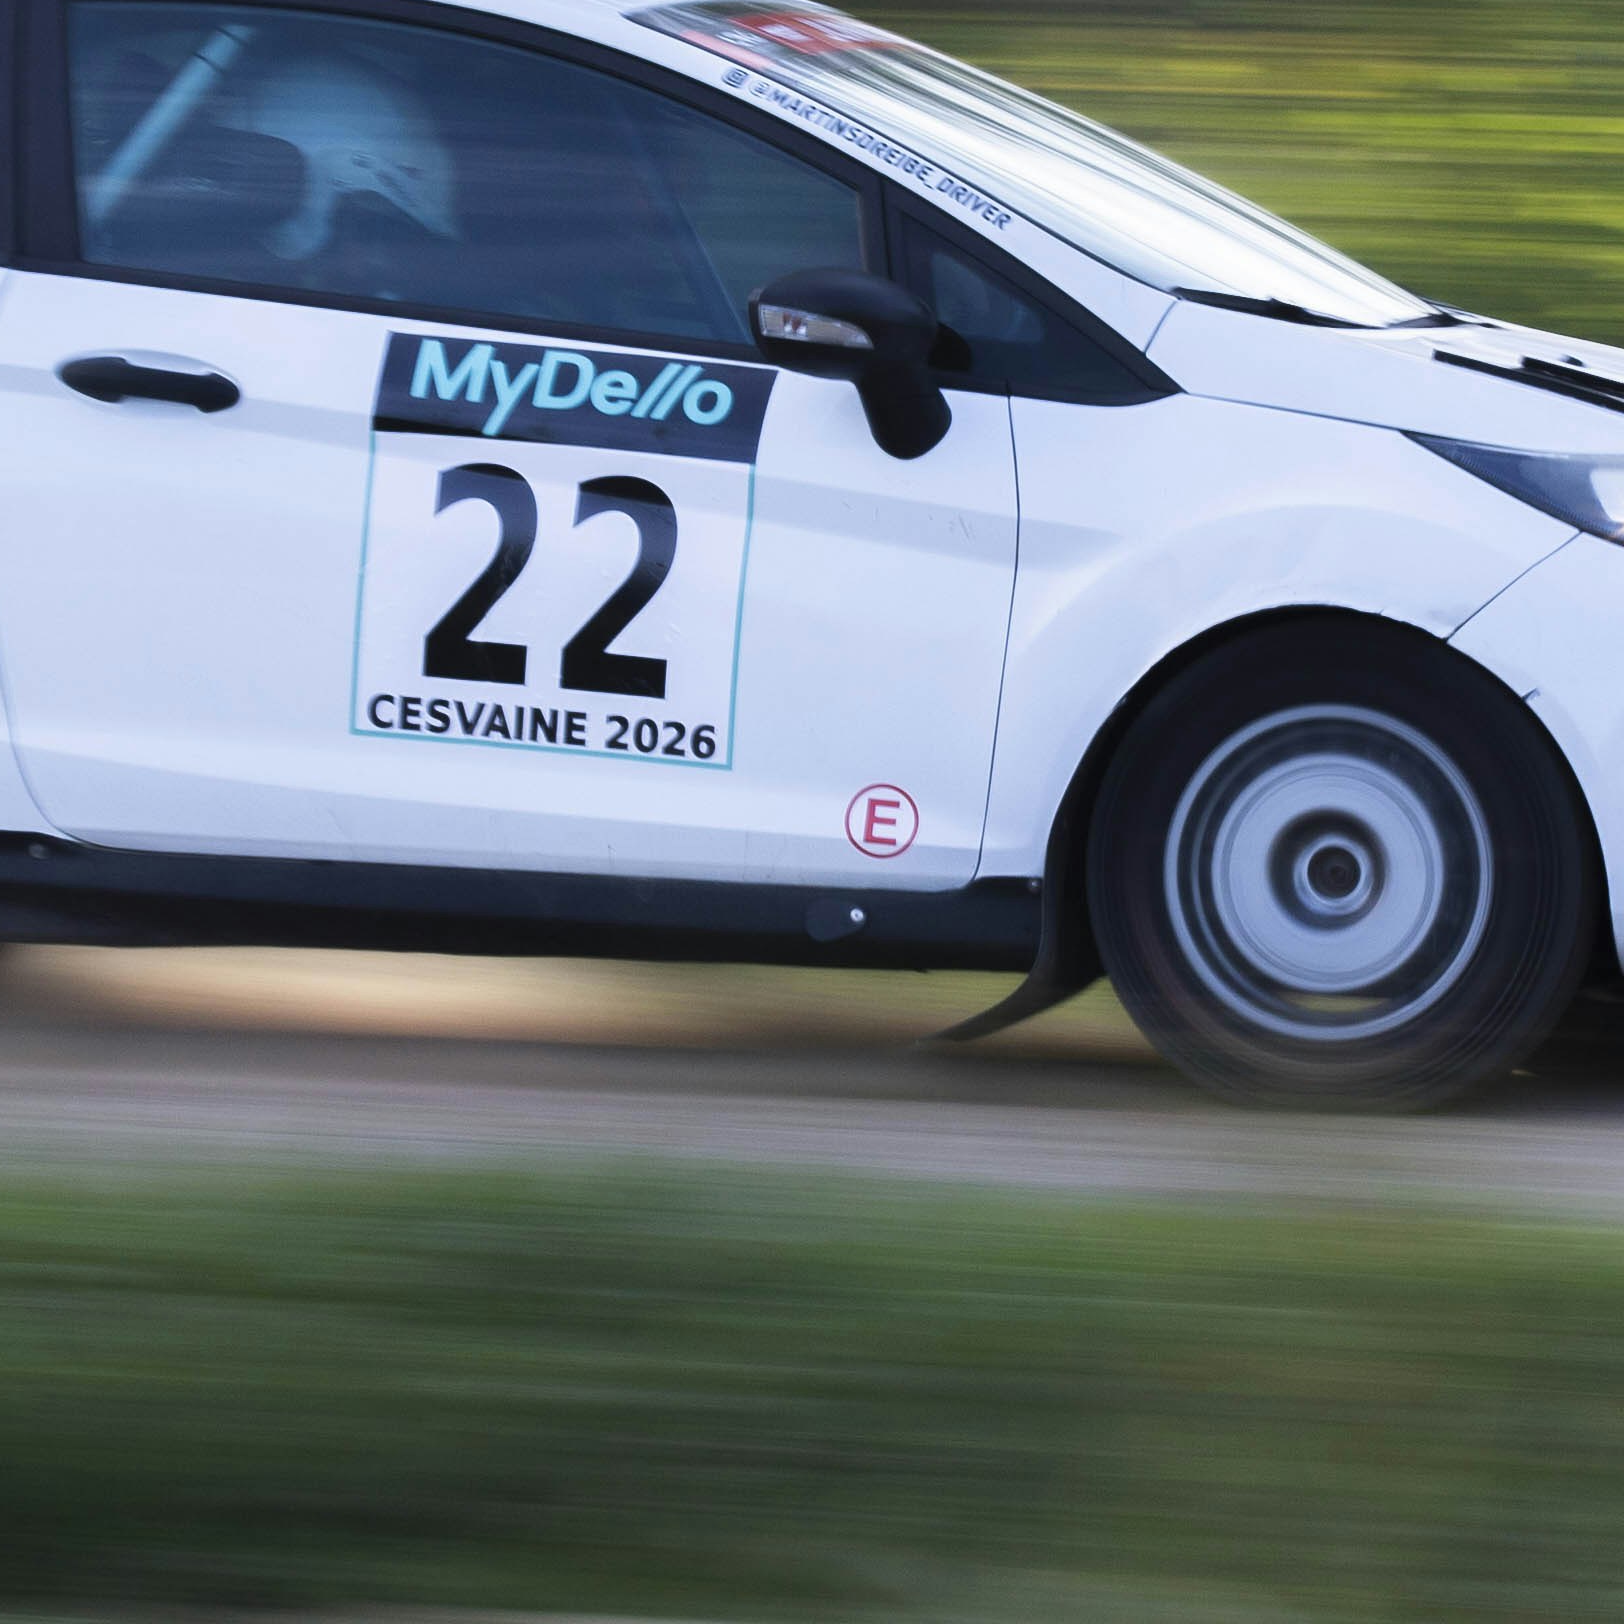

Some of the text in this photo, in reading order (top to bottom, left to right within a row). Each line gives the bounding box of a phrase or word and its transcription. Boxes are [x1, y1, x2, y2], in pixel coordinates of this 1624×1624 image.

[410, 338, 733, 436] MyDello
[421, 462, 678, 699] 22
[366, 693, 717, 760] CESVAINE 2026
[863, 797, 901, 846] E
